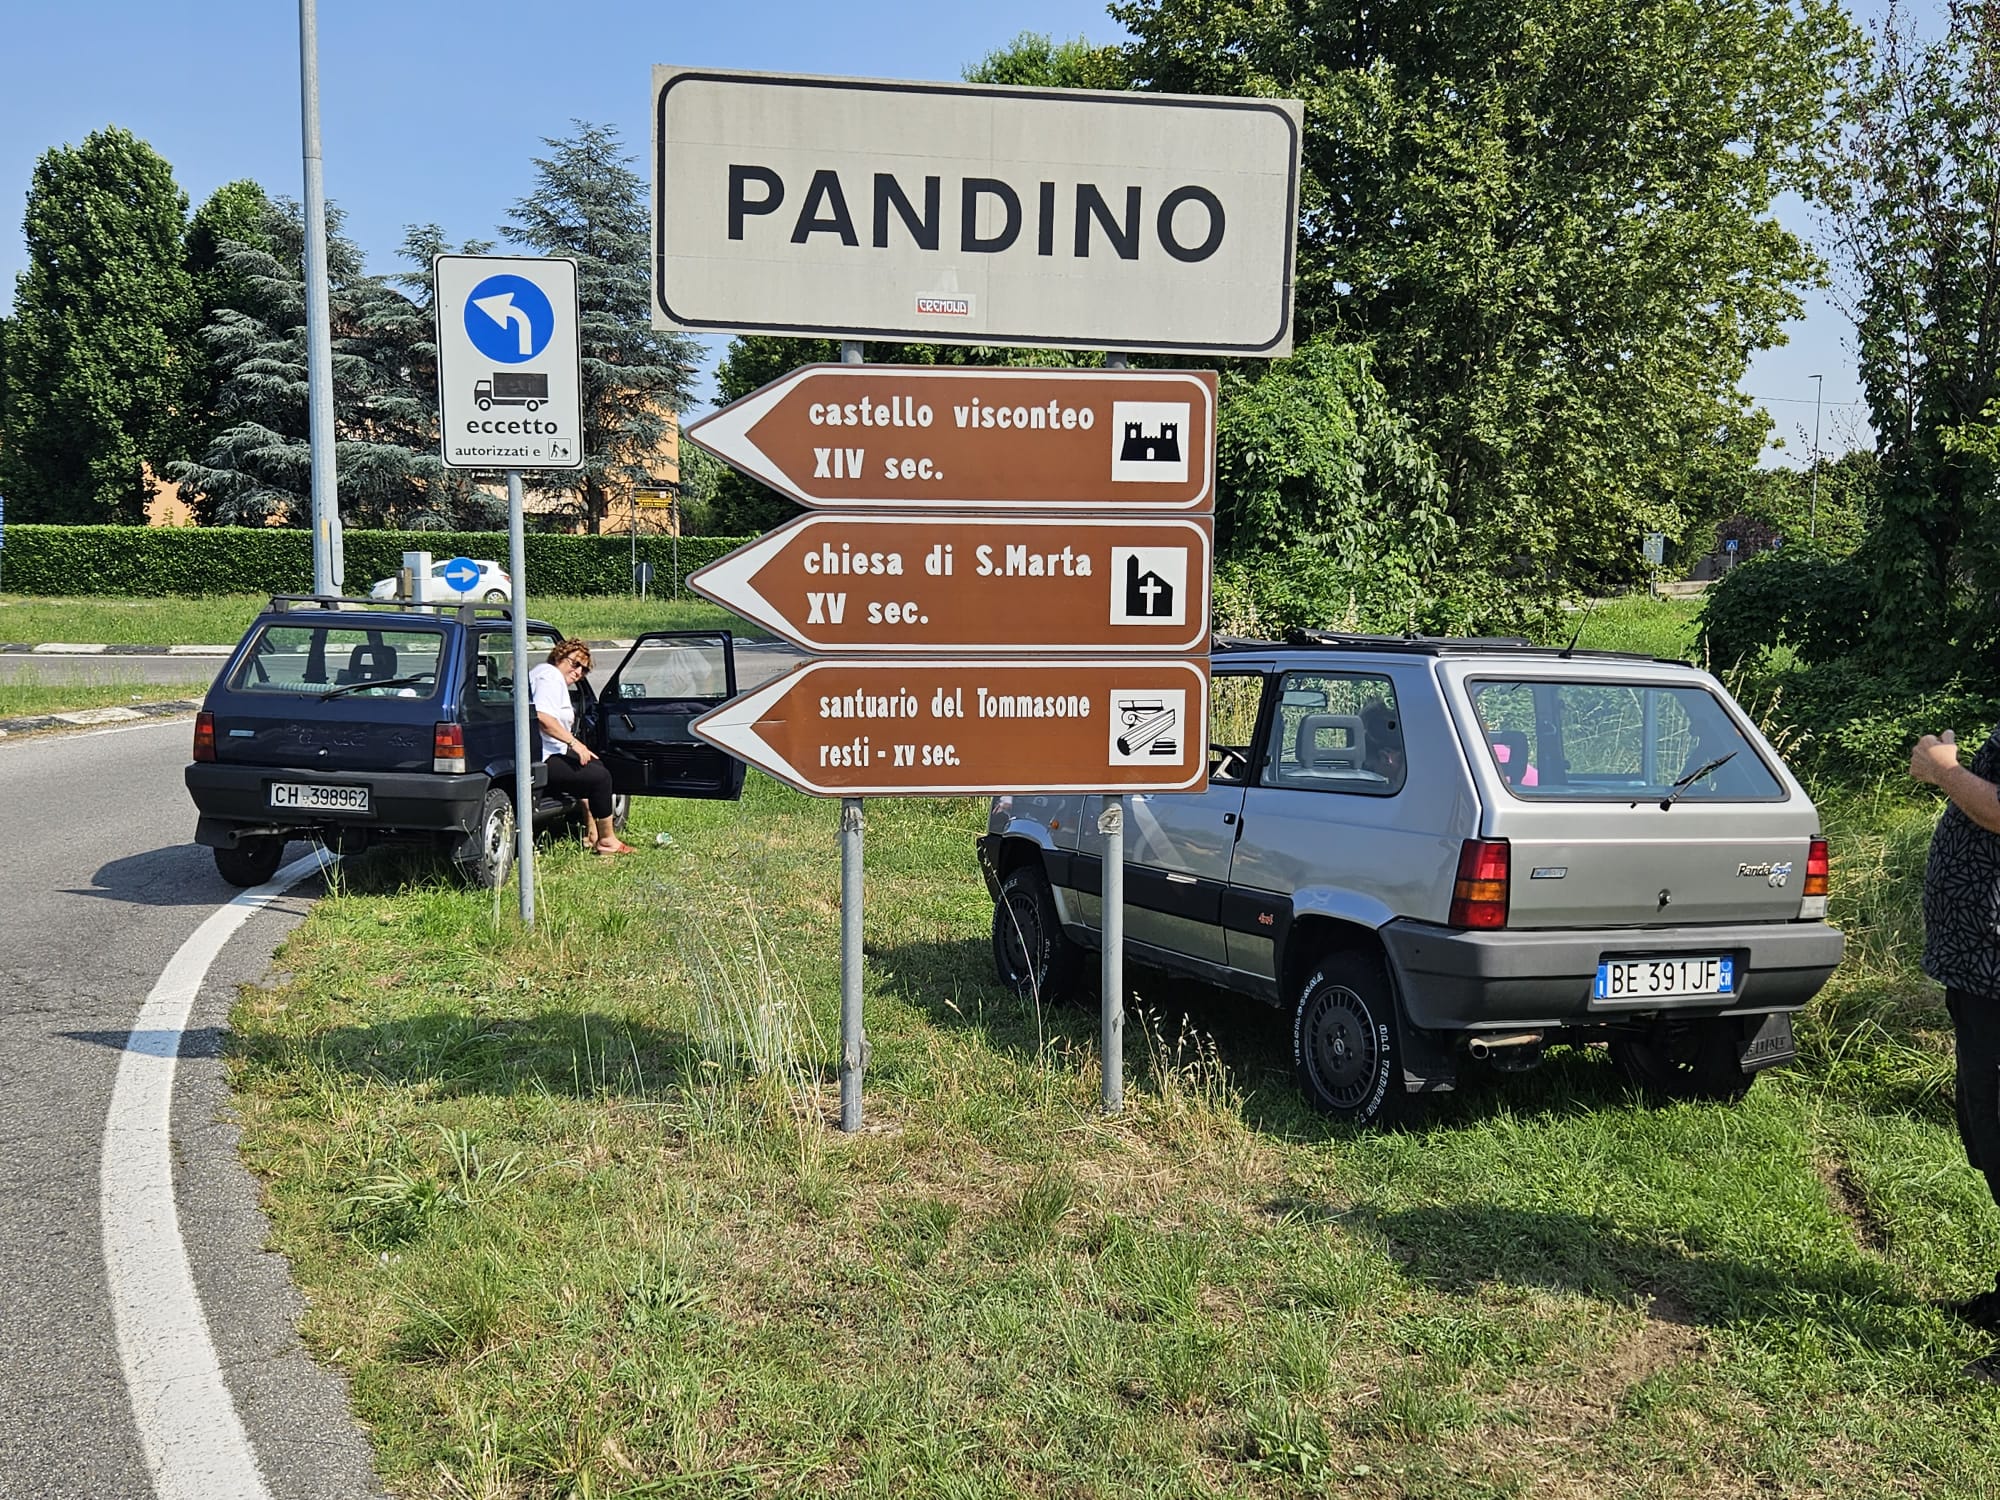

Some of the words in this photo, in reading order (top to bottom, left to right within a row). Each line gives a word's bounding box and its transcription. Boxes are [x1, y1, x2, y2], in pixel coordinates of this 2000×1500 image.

[727, 163, 1226, 263] PANDINO
[466, 418, 558, 435] eccetto
[808, 396, 933, 428] castello
[953, 397, 1095, 430] visconteo
[455, 444, 529, 457] autorizzati
[533, 448, 541, 457] e
[813, 447, 865, 479] XIV
[884, 457, 944, 480] sec.
[803, 543, 904, 576] chiesa
[925, 543, 954, 577] di
[975, 543, 1093, 577] S.Marta
[806, 592, 847, 625] XV
[867, 601, 929, 624] sec.
[819, 687, 918, 719] santuario
[931, 687, 964, 718] del
[976, 687, 1091, 719] Tommasone
[819, 736, 869, 767] resti
[922, 743, 961, 767] sec.
[275, 786, 299, 805] CH
[310, 787, 368, 808] 398962
[1736, 862, 1770, 877] Panda
[1611, 963, 1640, 994] BE
[1648, 960, 1718, 992] 391JF
[1719, 971, 1732, 987] CH
